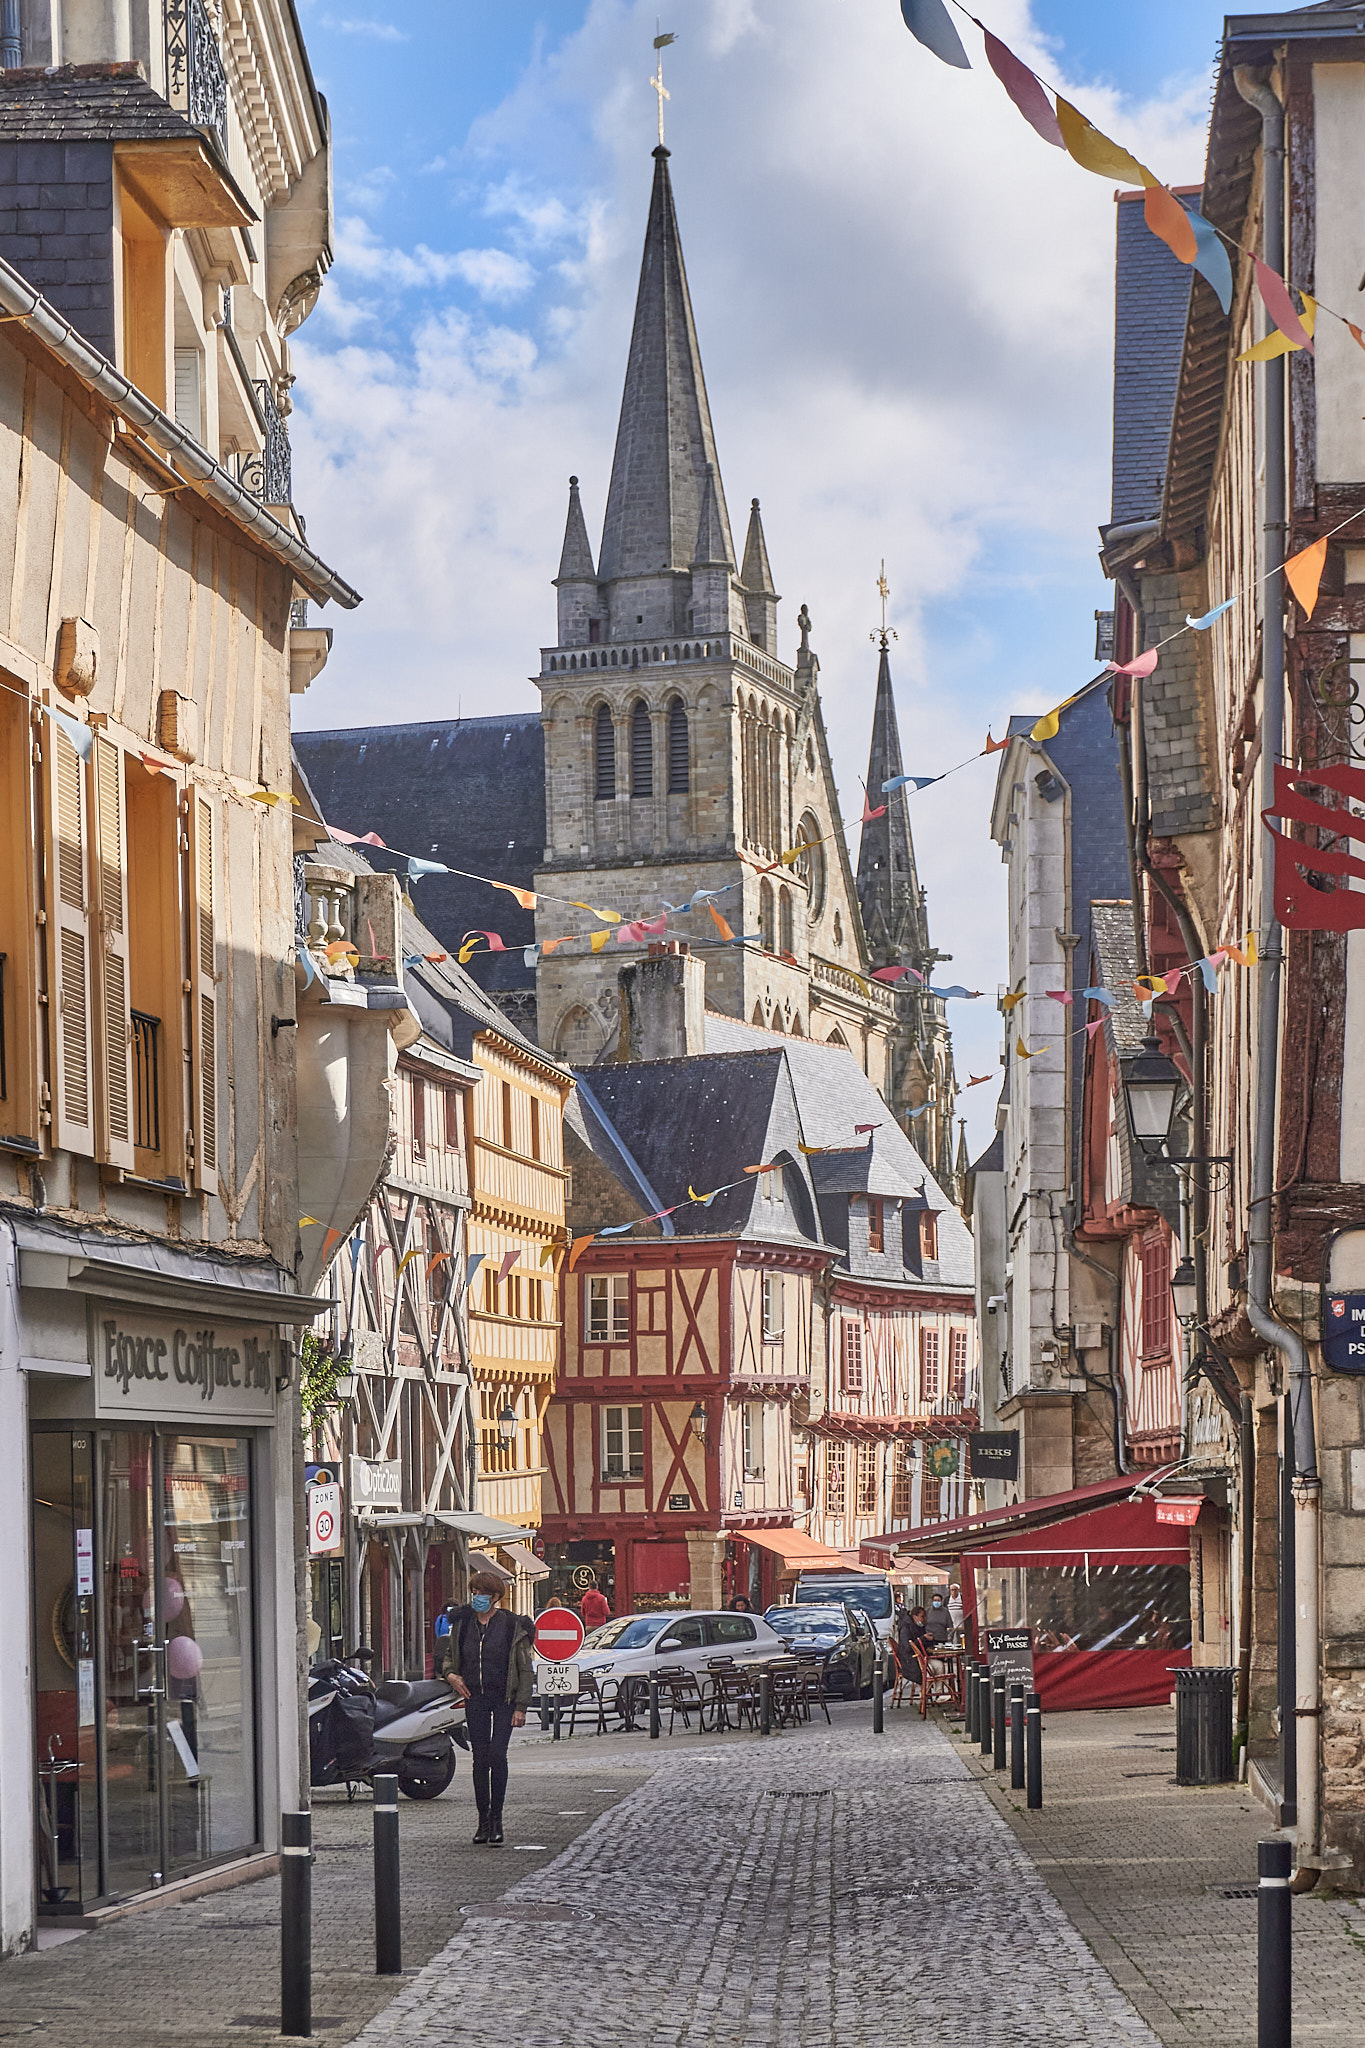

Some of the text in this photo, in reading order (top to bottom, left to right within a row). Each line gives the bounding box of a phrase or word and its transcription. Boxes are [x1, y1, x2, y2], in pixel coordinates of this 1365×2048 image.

[104, 1320, 168, 1394] Espace
[173, 1329, 241, 1400] Coiffure
[978, 1448, 1012, 1457] IKKS
[315, 1491, 334, 1504] ZONE
[319, 1519, 330, 1533] 30
[1006, 1641, 1028, 1649] PASSE
[547, 1666, 570, 1675] SAUF
